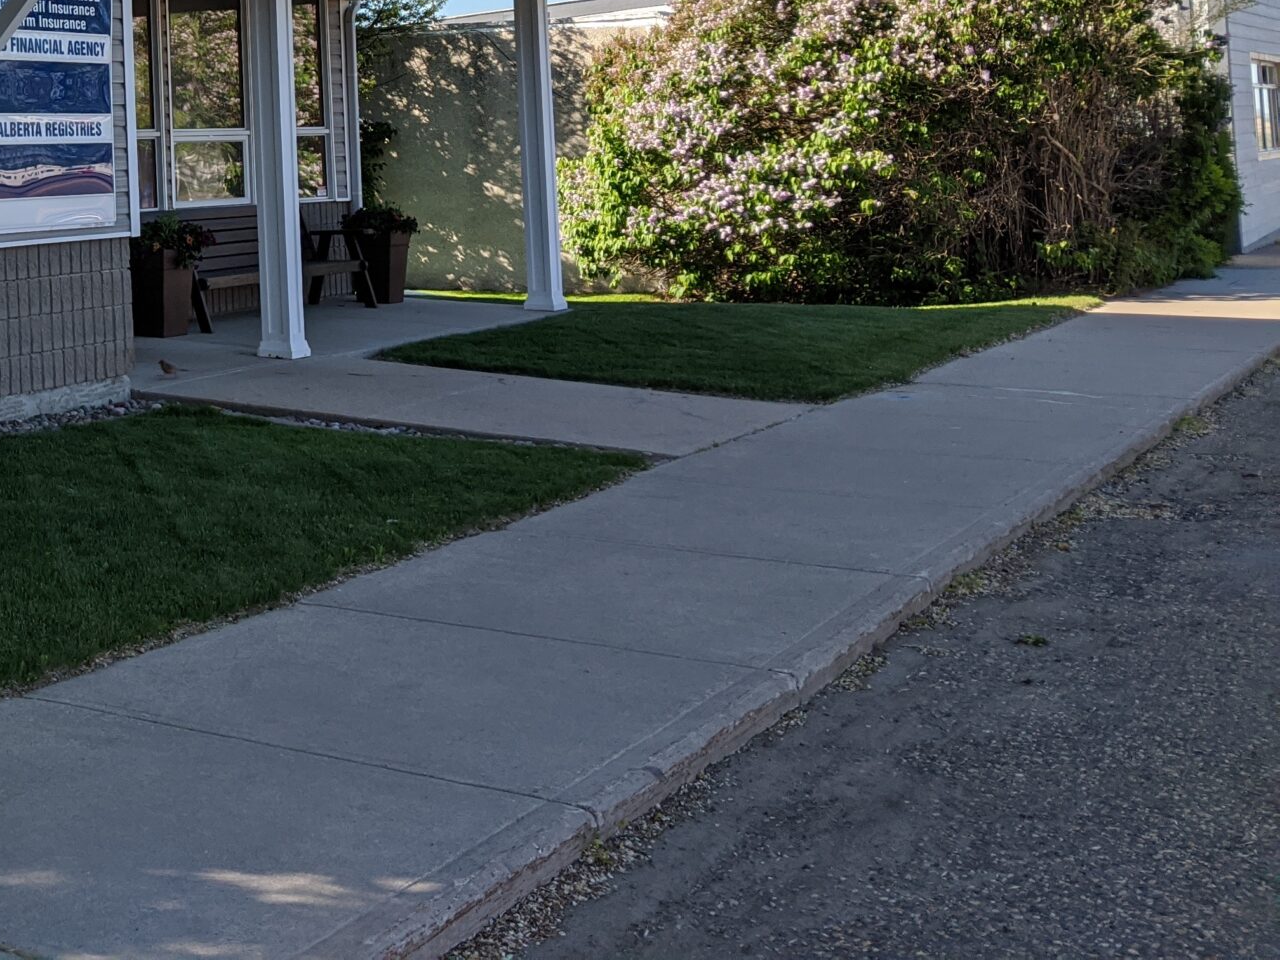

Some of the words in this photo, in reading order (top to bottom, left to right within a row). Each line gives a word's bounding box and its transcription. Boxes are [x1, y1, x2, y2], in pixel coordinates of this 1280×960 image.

[48, 3, 96, 16] Insurance
[39, 16, 87, 30] Insurance
[10, 37, 64, 55] FINANCIAL
[67, 41, 105, 57] AGENCY
[45, 121, 102, 138] REGISTRIES
